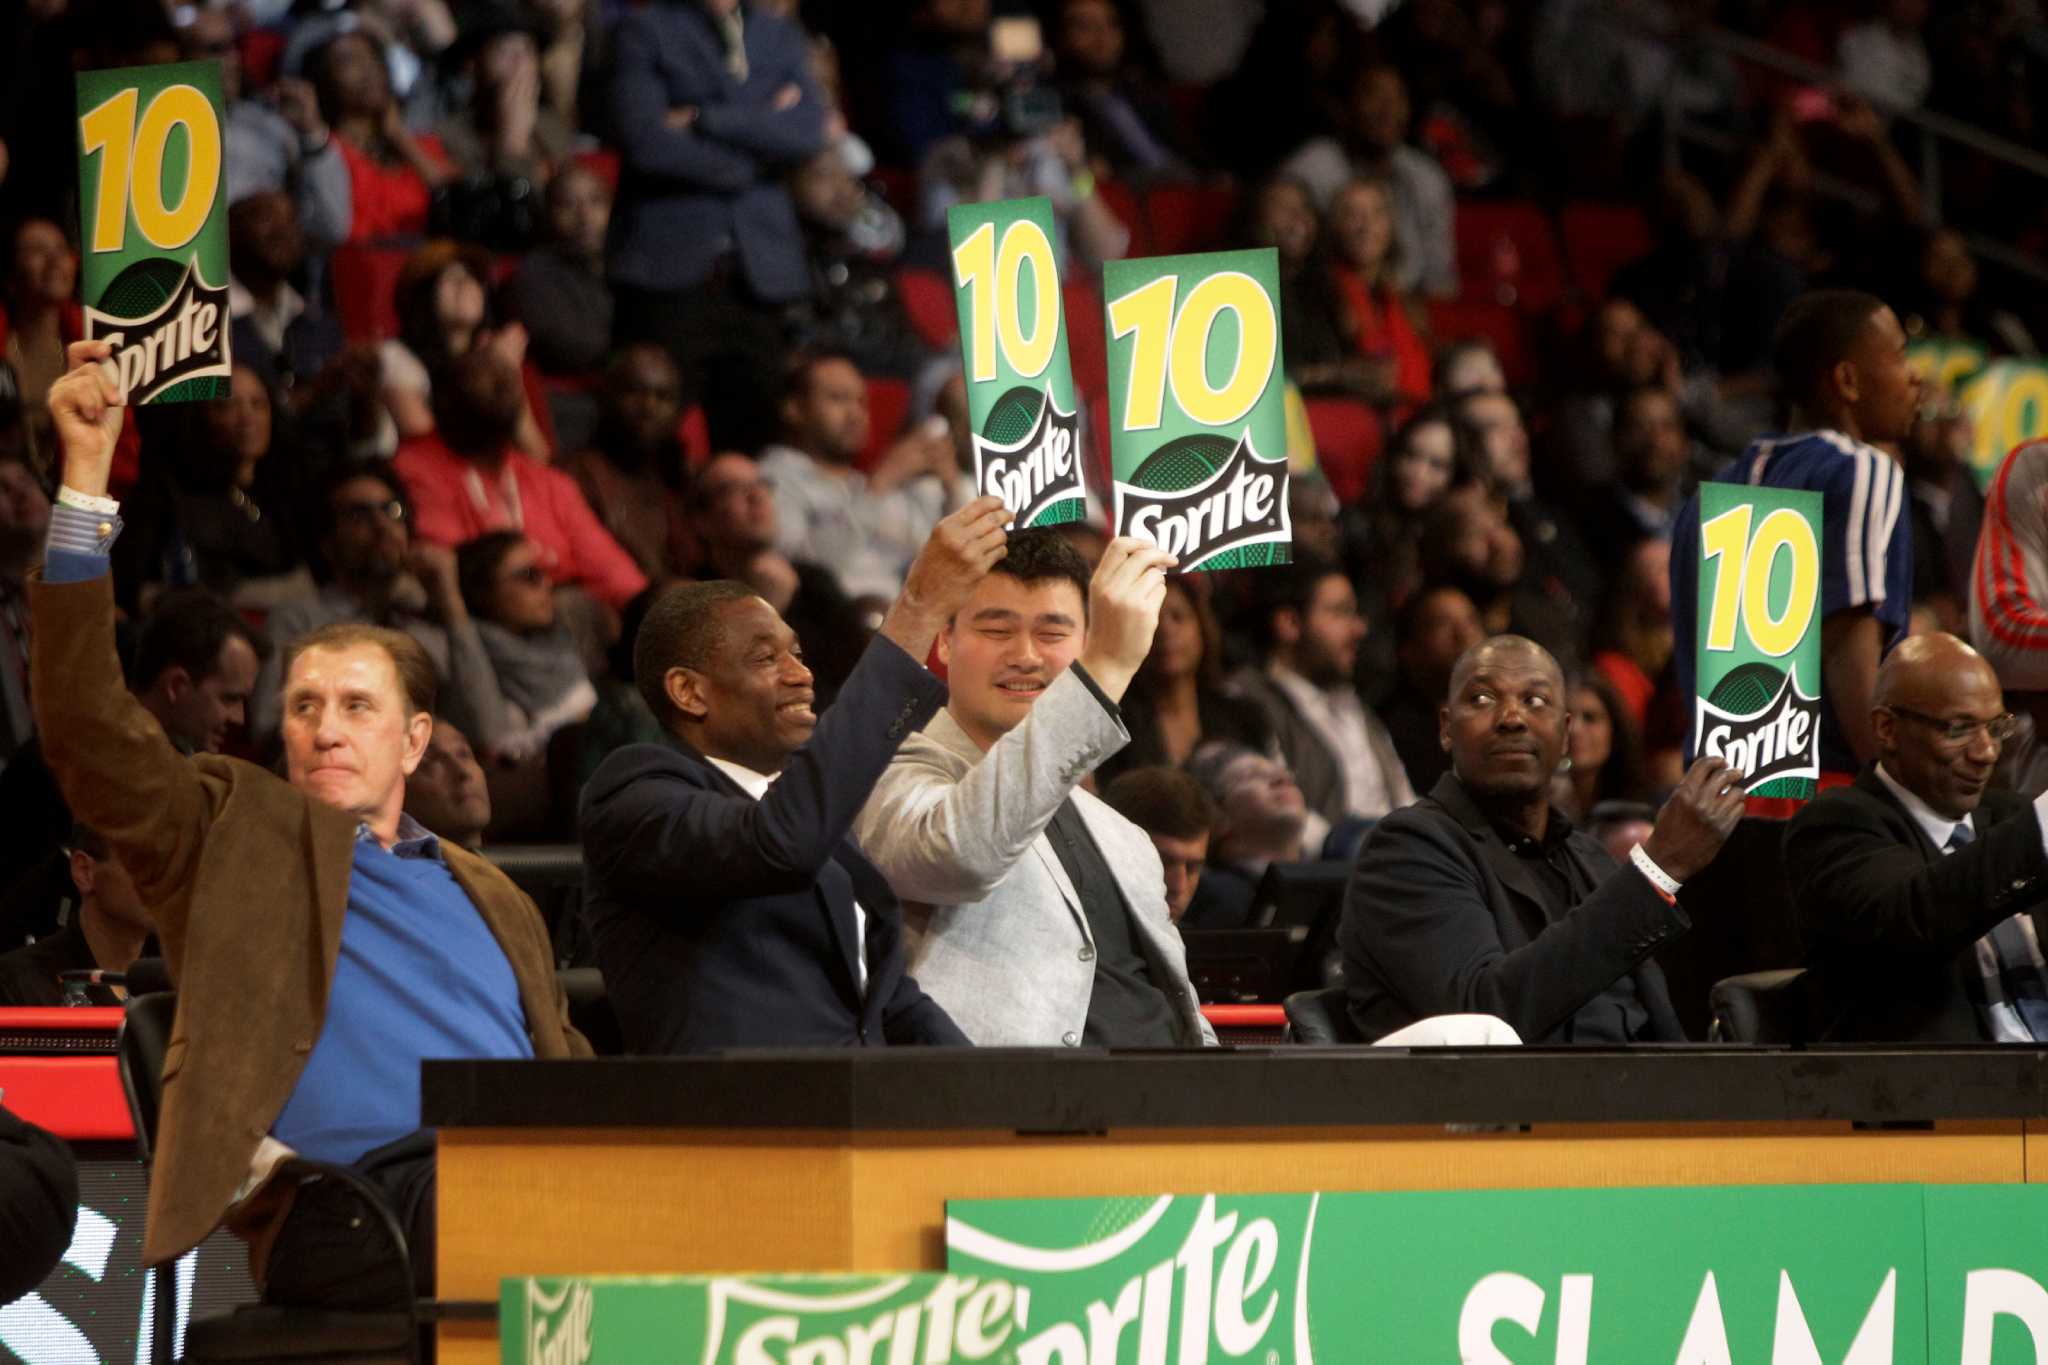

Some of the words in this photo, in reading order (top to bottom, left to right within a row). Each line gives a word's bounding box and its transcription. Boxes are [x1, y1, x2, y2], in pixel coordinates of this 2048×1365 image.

[80, 84, 221, 253] 10
[103, 288, 218, 405] Sprite
[953, 219, 1060, 382] 10
[1108, 271, 1277, 431] 10
[986, 414, 1072, 531] Sprite
[1130, 460, 1274, 573] Sprite
[1702, 504, 1819, 657] 10
[1706, 693, 1809, 794] Sprite
[733, 1276, 1014, 1365] Srite
[1015, 1193, 1279, 1365] rite
